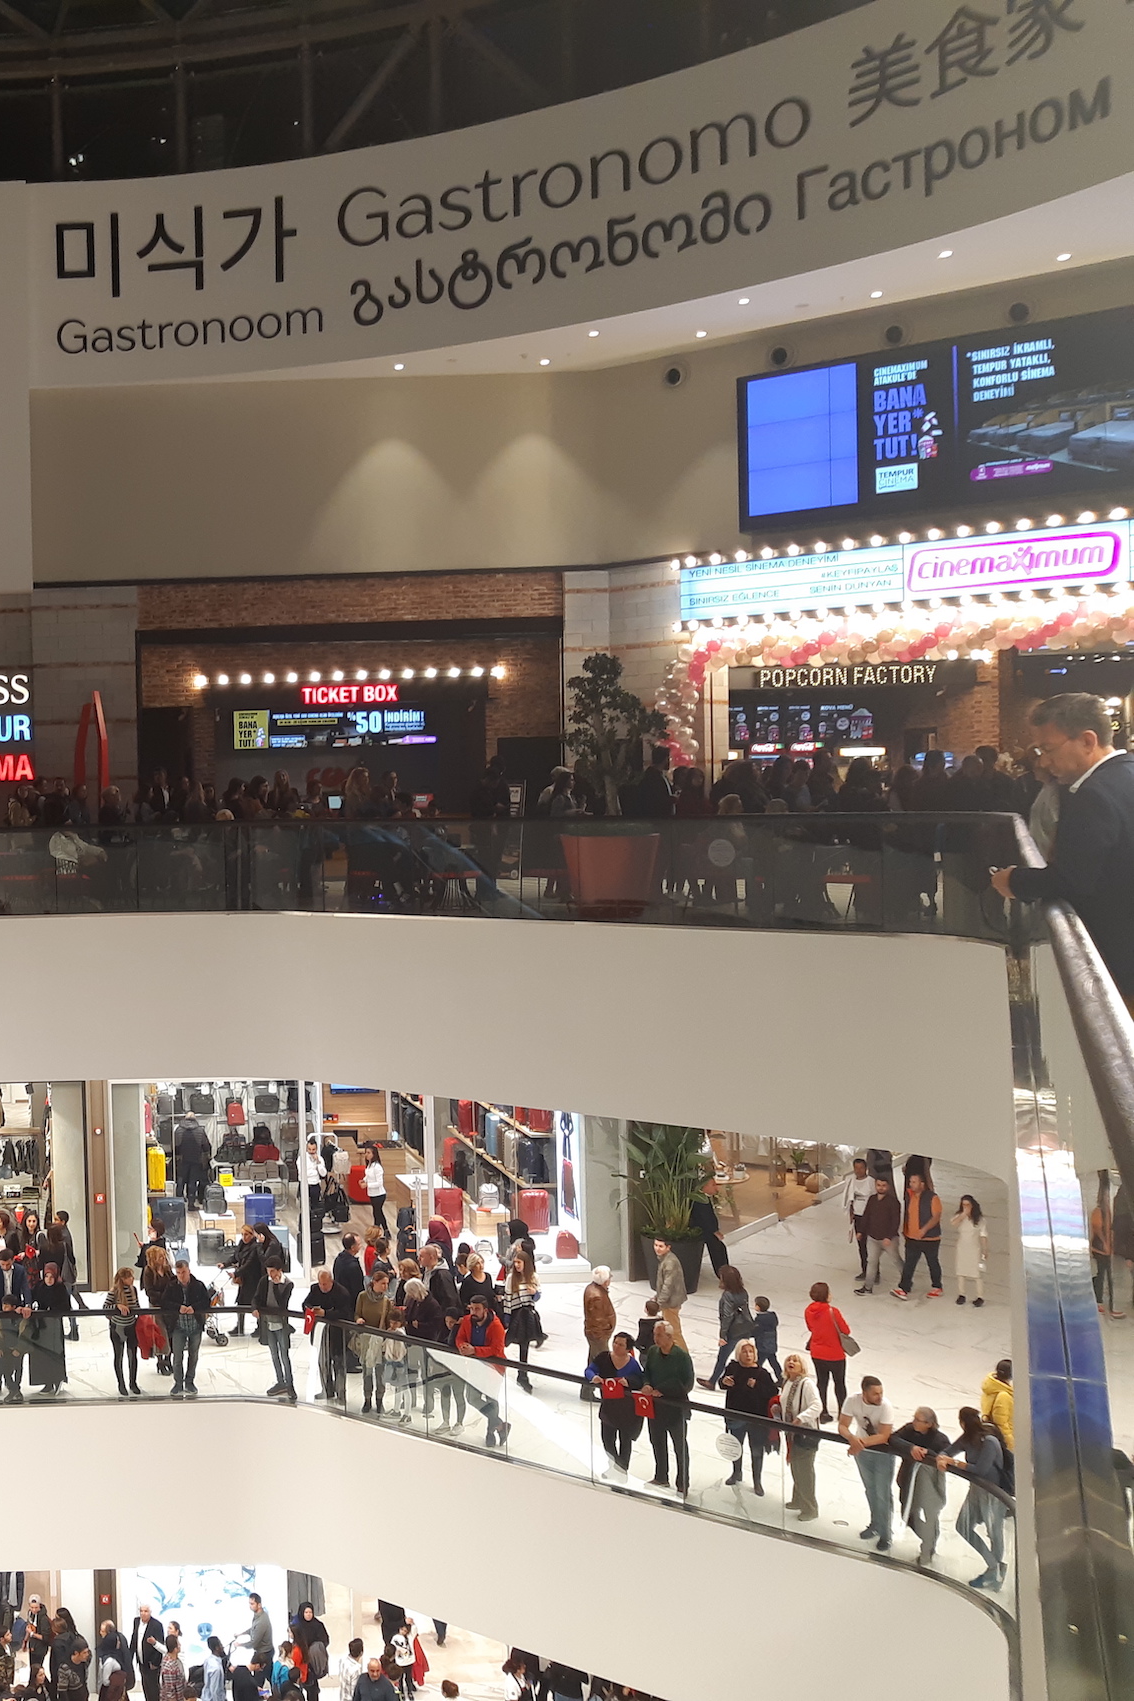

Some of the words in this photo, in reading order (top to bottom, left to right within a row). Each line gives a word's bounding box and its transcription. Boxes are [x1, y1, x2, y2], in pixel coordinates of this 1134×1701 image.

[796, 75, 1113, 221] Гастроном
[336, 96, 812, 247] Gastronomo
[55, 195, 297, 298] 미식가
[349, 189, 773, 327] გასტრონომი
[56, 302, 324, 355] Gastronoom
[972, 359, 1008, 375] TEMPUR
[972, 371, 1019, 389] KONFORLU
[873, 383, 927, 413] BANA
[873, 433, 918, 461] TUT!
[878, 467, 915, 480] TEMPUR
[759, 667, 849, 688] POPCORN
[852, 664, 937, 686] FACTORY
[302, 685, 360, 705] TICKET
[364, 684, 398, 702] BOX
[238, 721, 258, 730] BANA
[384, 708, 425, 723] İNDİRİM!
[238, 739, 255, 748] TUT!
